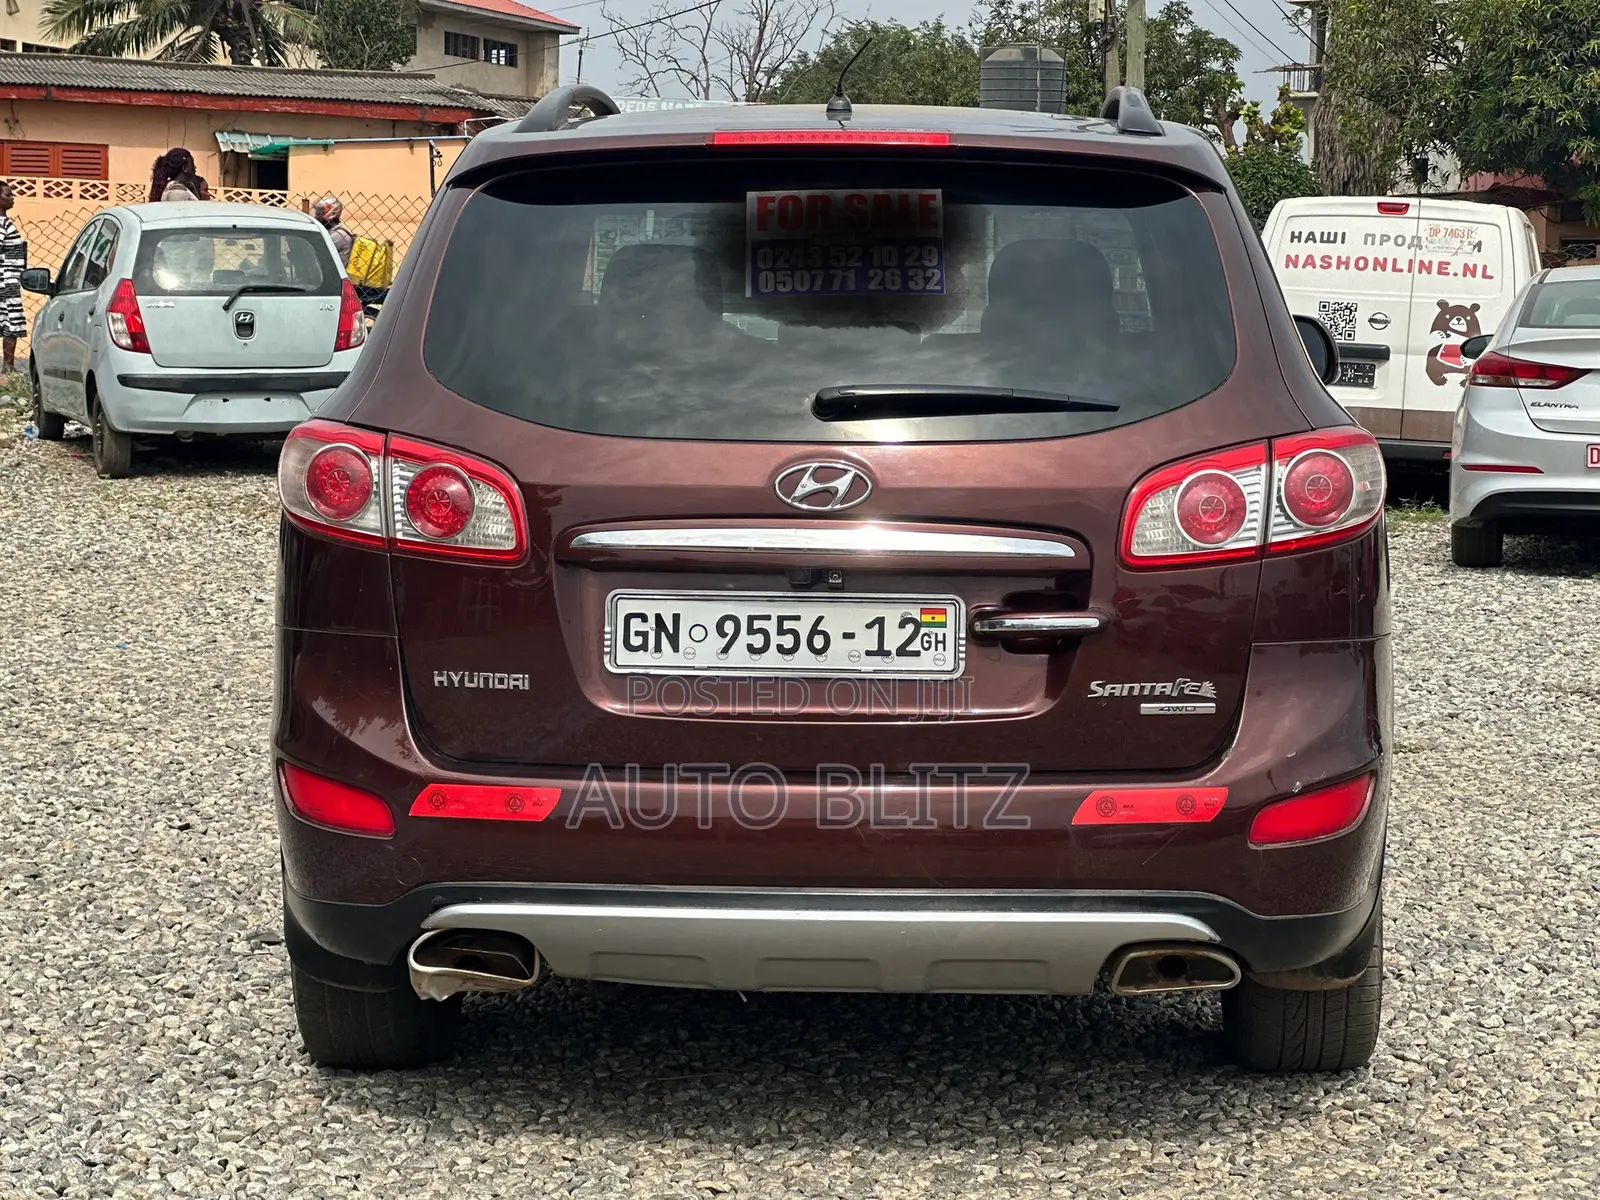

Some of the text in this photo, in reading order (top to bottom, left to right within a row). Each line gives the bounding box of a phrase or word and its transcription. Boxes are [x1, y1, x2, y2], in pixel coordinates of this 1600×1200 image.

[757, 193, 938, 232] FOR SALE
[1289, 230, 1347, 245] НАШІ
[757, 245, 939, 270] 0243 52 10 29
[1284, 253, 1495, 280] NASHONLINE.NL
[758, 268, 942, 293] 0507 71 26 32
[1530, 401, 1579, 409] ELANTRA
[622, 611, 681, 654] GN
[921, 632, 947, 652] GH
[433, 670, 530, 691] HYUNDAI
[1158, 705, 1197, 713] 4WD
